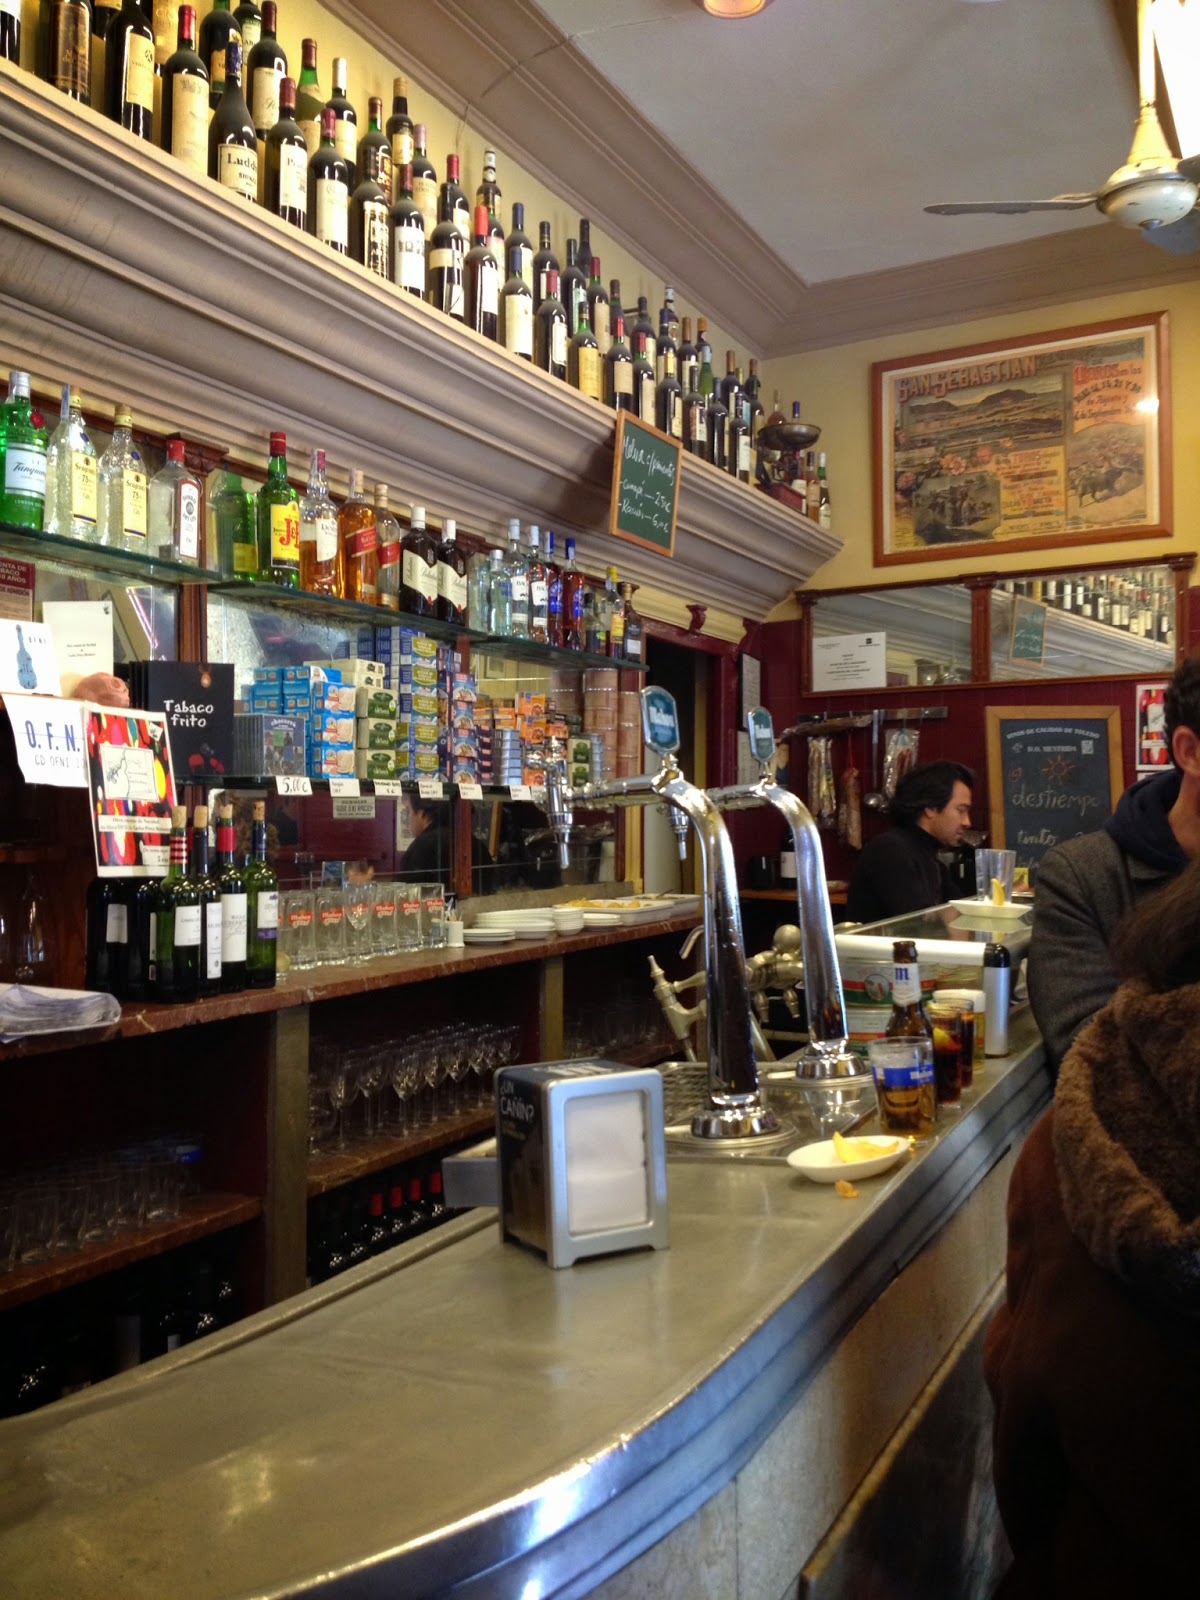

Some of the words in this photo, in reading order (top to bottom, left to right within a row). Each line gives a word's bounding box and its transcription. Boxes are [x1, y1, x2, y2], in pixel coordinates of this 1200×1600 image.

[898, 372, 932, 403] SAN
[934, 354, 1037, 398] SEBASTIAN
[163, 699, 214, 714] Tabaco
[171, 713, 207, 728] frito
